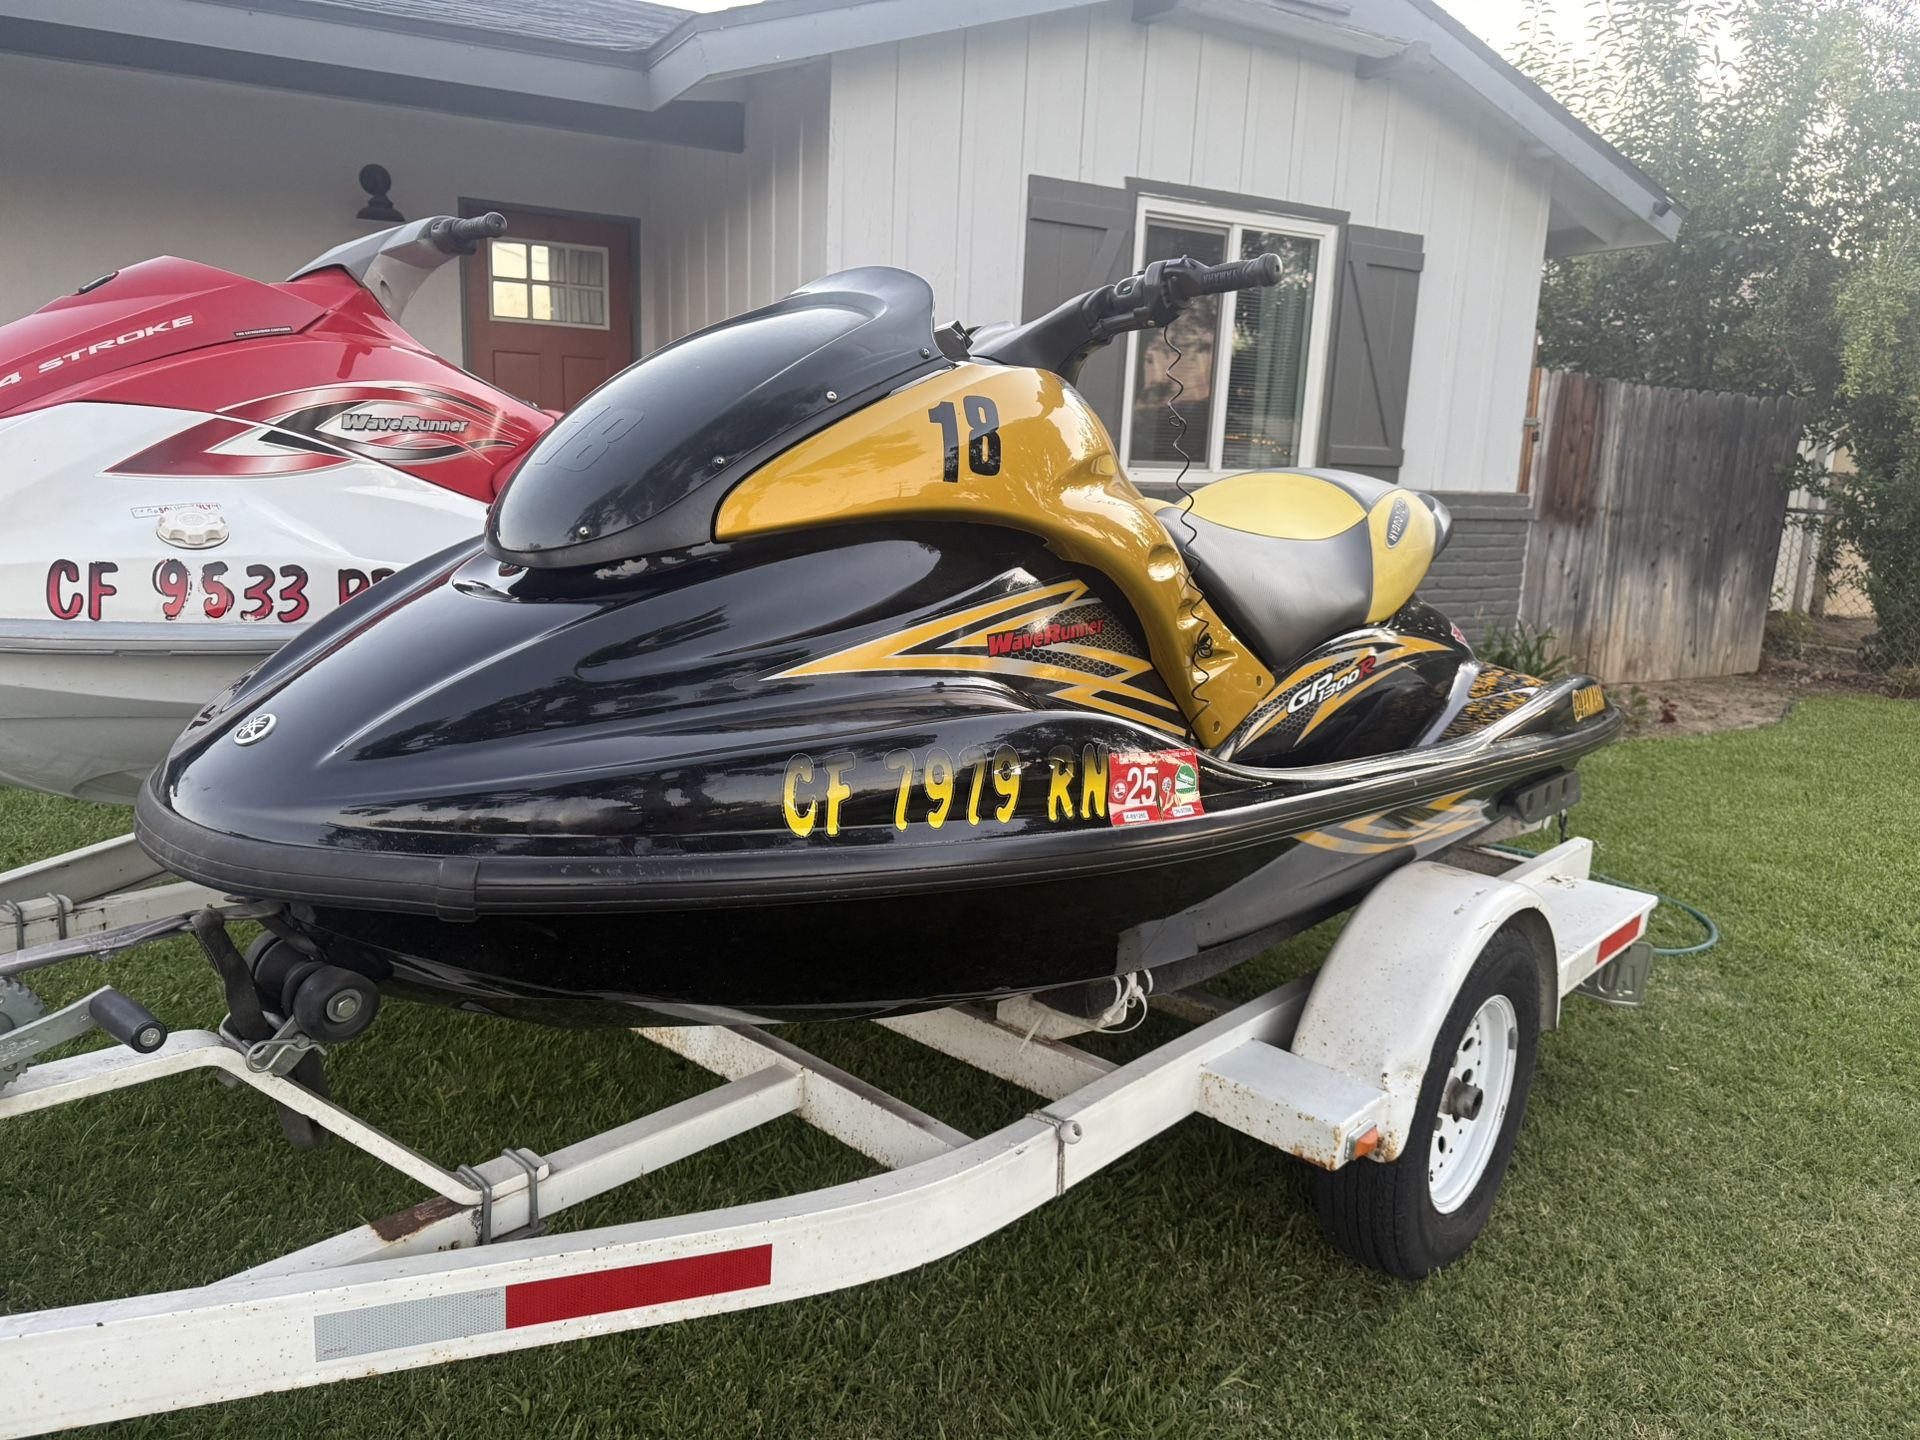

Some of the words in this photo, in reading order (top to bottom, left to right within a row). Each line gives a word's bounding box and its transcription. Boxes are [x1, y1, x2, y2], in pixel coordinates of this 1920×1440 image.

[0, 371, 21, 387] 4
[39, 315, 193, 373] STROKE
[341, 413, 469, 432] WaveRunner
[928, 395, 1001, 482] 18
[46, 559, 118, 621] CF
[152, 558, 309, 623] 9533
[987, 619, 1104, 657] WaveRunner
[782, 752, 856, 837] CF
[883, 744, 1022, 832] 7979
[1048, 742, 1110, 822] RN
[1125, 767, 1158, 806] 25
